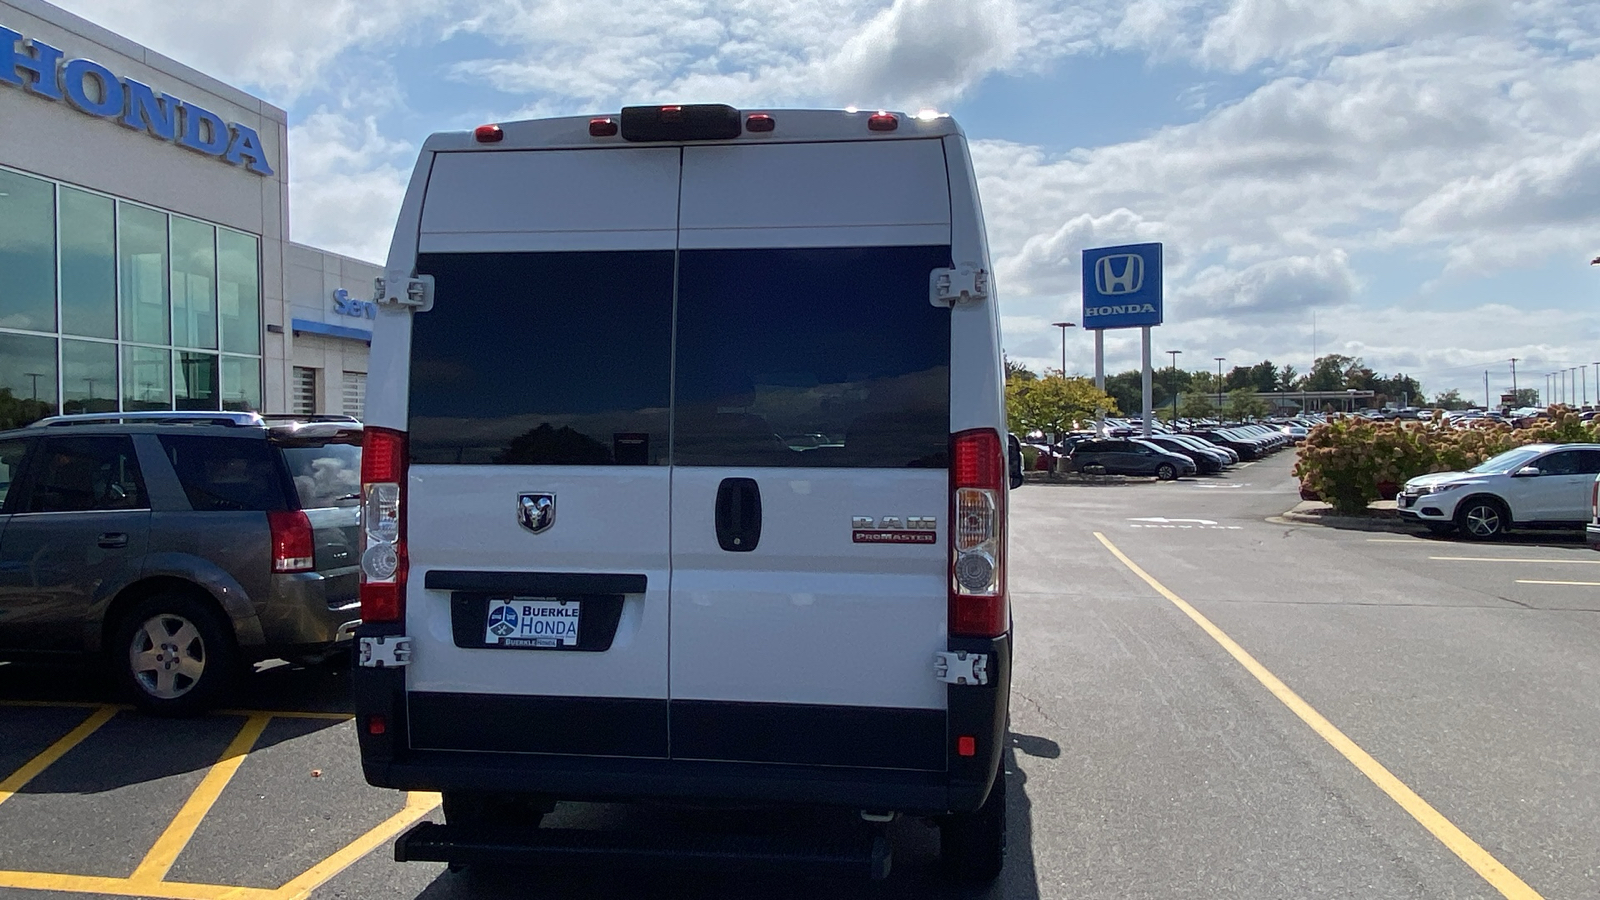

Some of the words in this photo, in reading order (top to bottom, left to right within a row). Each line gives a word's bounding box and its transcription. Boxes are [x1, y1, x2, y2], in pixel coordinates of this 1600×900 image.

[0, 24, 274, 176] HONDA
[1085, 303, 1156, 316] HONDA
[852, 516, 937, 529] RAM
[523, 606, 579, 617] BUERKLE
[521, 617, 576, 634] HONDA
